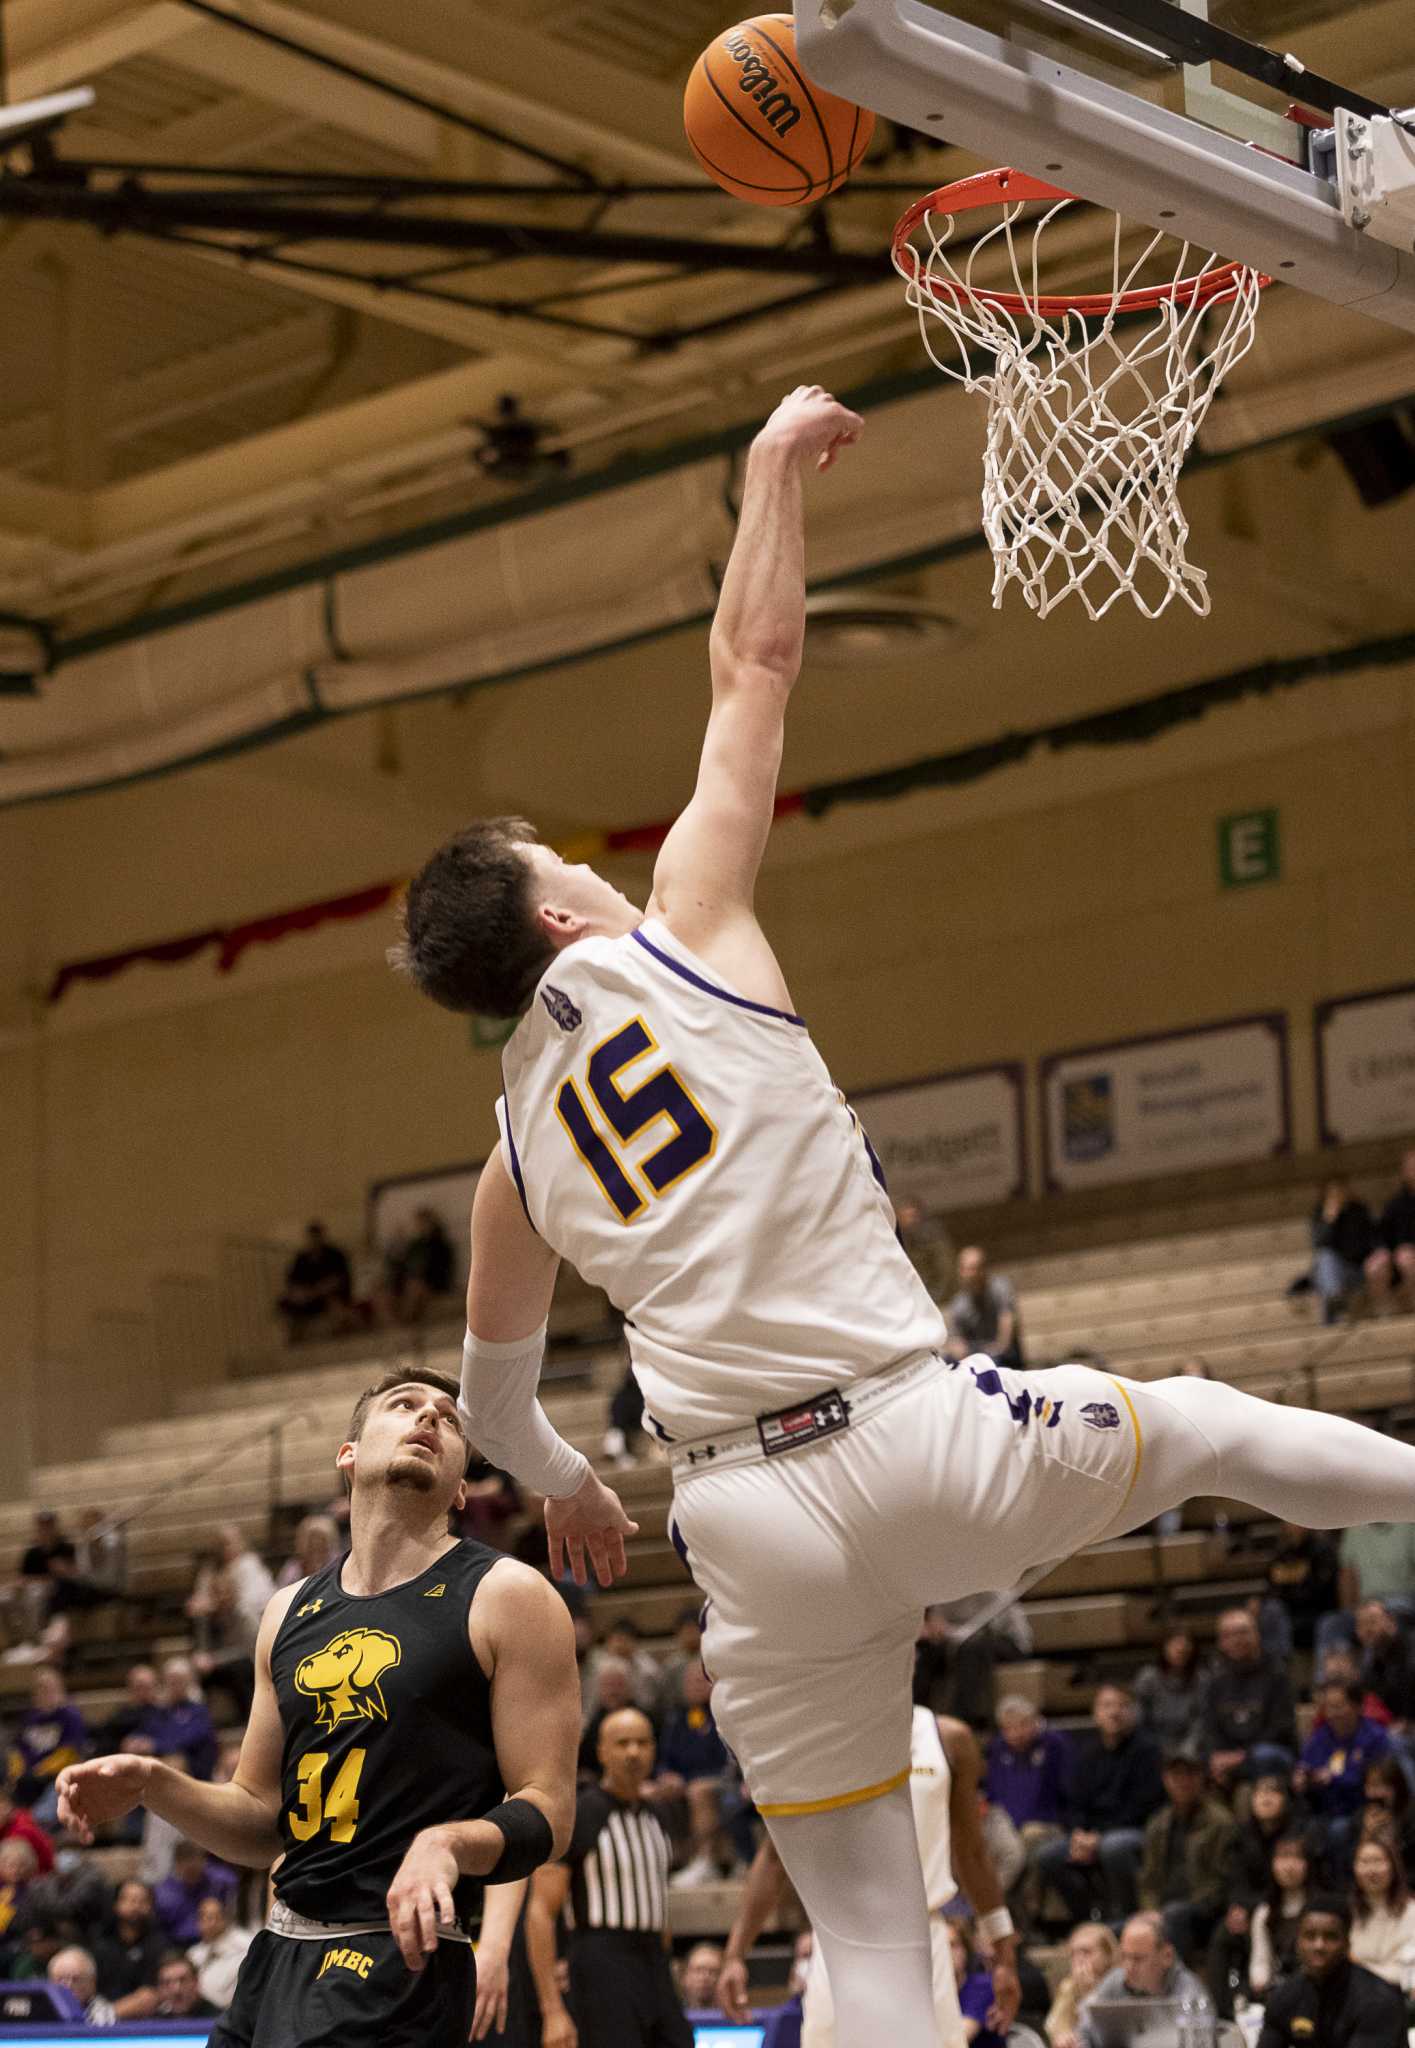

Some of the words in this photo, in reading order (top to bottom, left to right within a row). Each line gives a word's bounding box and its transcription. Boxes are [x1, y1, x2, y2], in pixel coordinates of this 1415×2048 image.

[724, 30, 800, 138] Wilson
[1231, 820, 1265, 879] E
[554, 1013, 719, 1227] 15
[288, 1748, 366, 1844] 34
